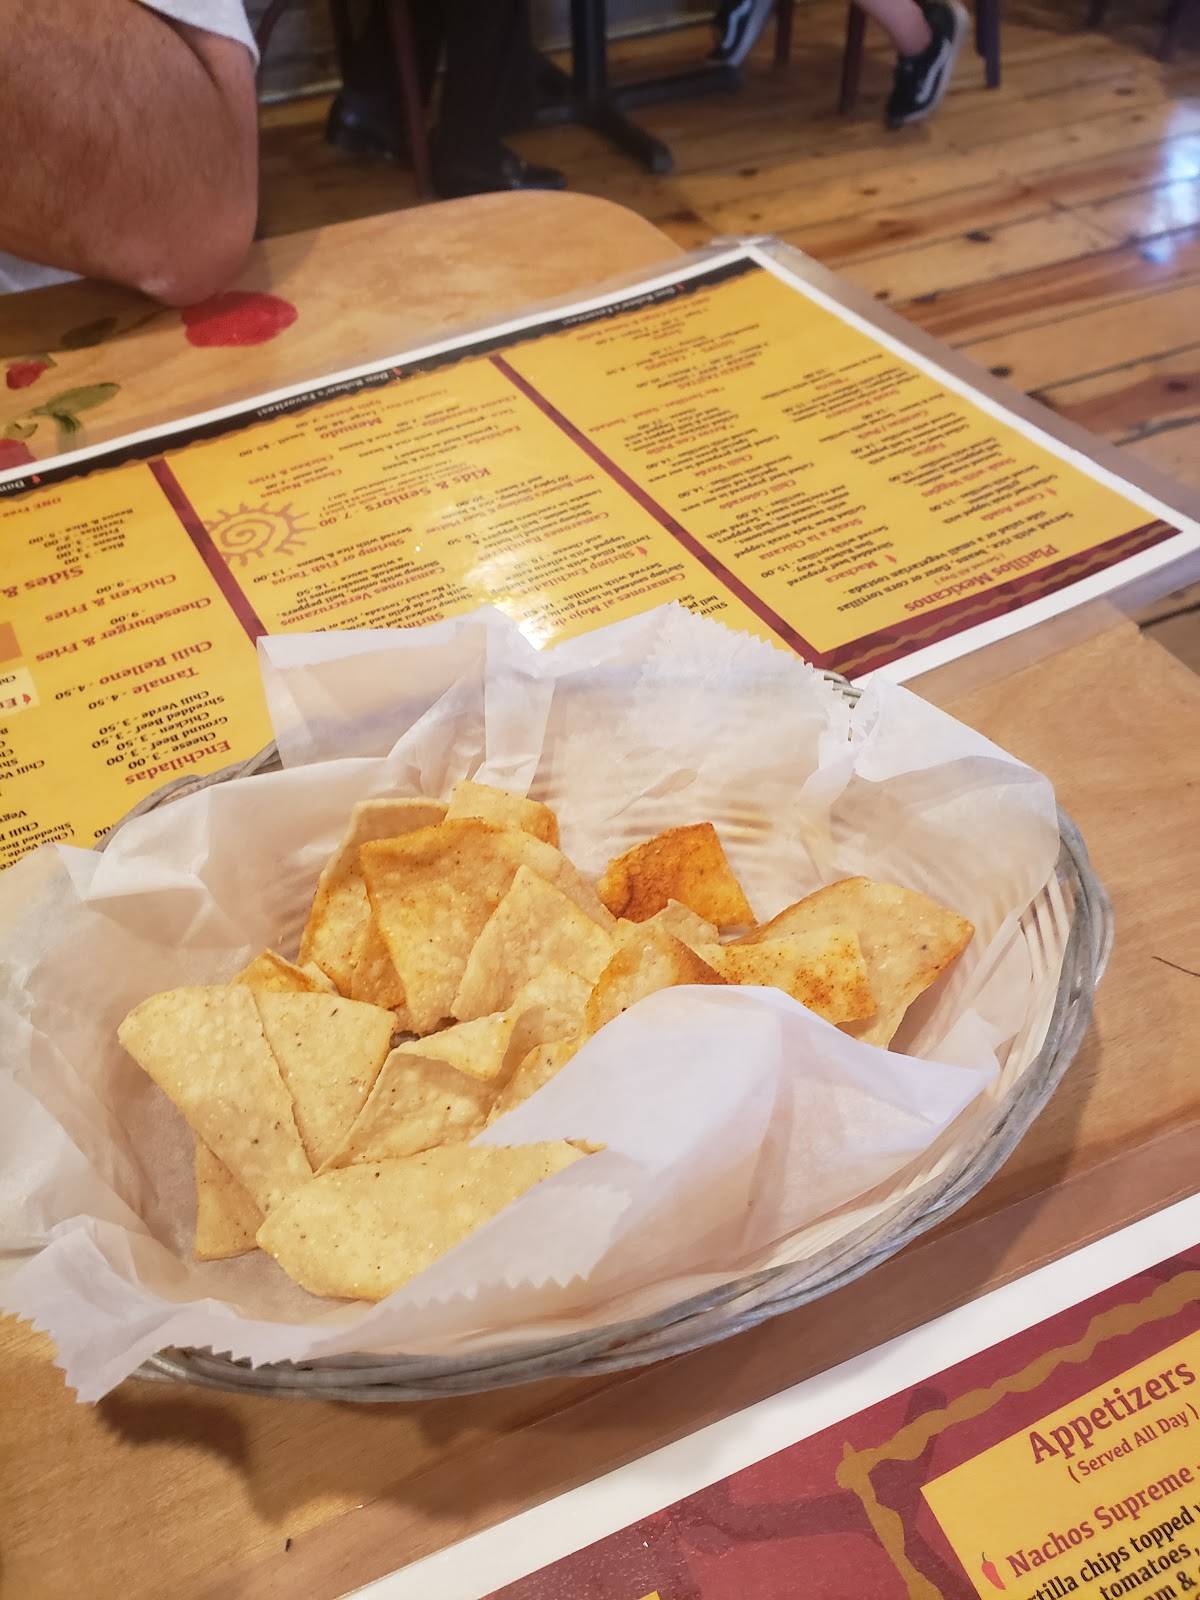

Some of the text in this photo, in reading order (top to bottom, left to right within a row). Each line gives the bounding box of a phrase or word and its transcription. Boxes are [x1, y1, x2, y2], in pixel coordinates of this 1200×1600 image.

[364, 467, 491, 512] Kids & Seniors
[829, 517, 863, 533] Steak
[1037, 511, 1074, 529] Served
[355, 537, 378, 548] with
[379, 526, 412, 541] Served
[806, 533, 820, 541] la
[834, 537, 856, 548] with
[856, 525, 889, 540] Served
[985, 531, 997, 539] or
[1012, 526, 1036, 539] with
[758, 539, 806, 560] Chicana
[796, 545, 835, 563] tortillas
[947, 540, 976, 555] small
[271, 538, 404, 585] Shrimp or Fish Tacos
[403, 560, 439, 575] Shrimp
[649, 563, 684, 578] Shrimp
[786, 541, 893, 586] Shredded beef prepared
[824, 559, 878, 583] Machaca
[889, 552, 947, 577] vegetarian
[923, 563, 951, 577] flour
[1, 565, 83, 598] Sides &
[373, 566, 445, 594] Camarones
[379, 572, 402, 583] with
[562, 561, 662, 601] Served with tortillas
[616, 572, 685, 601] Camarones
[882, 579, 908, 592] corn
[904, 543, 1059, 611] Platillos Mexicanos
[910, 574, 922, 582] or
[44, 573, 176, 621] Chicken & Fries
[601, 589, 613, 597] in
[601, 598, 615, 608] al
[836, 590, 883, 611] tortillas
[280, 592, 372, 626] Veracruzanos
[568, 604, 602, 619] Mojo
[35, 597, 211, 661] Cheeseburger & Fries
[170, 640, 212, 661] Chili
[99, 656, 166, 684] Relleno
[132, 666, 198, 694] Tamale
[179, 690, 209, 705] Chili
[141, 702, 178, 718] Verde
[165, 696, 224, 721] Shredded
[135, 717, 163, 733] Beef
[159, 711, 209, 733] Chicken
[181, 716, 228, 738] Ground
[150, 733, 179, 750] Beef
[171, 731, 216, 752] Cheese
[124, 740, 230, 784] Enchiladas
[8, 821, 38, 837] Chili
[1029, 1363, 1196, 1464] Appetizers
[1077, 1410, 1189, 1476] Served All Day
[1006, 1467, 1195, 1578] Nachos Supreme
[1080, 1505, 1195, 1582] chips topped
